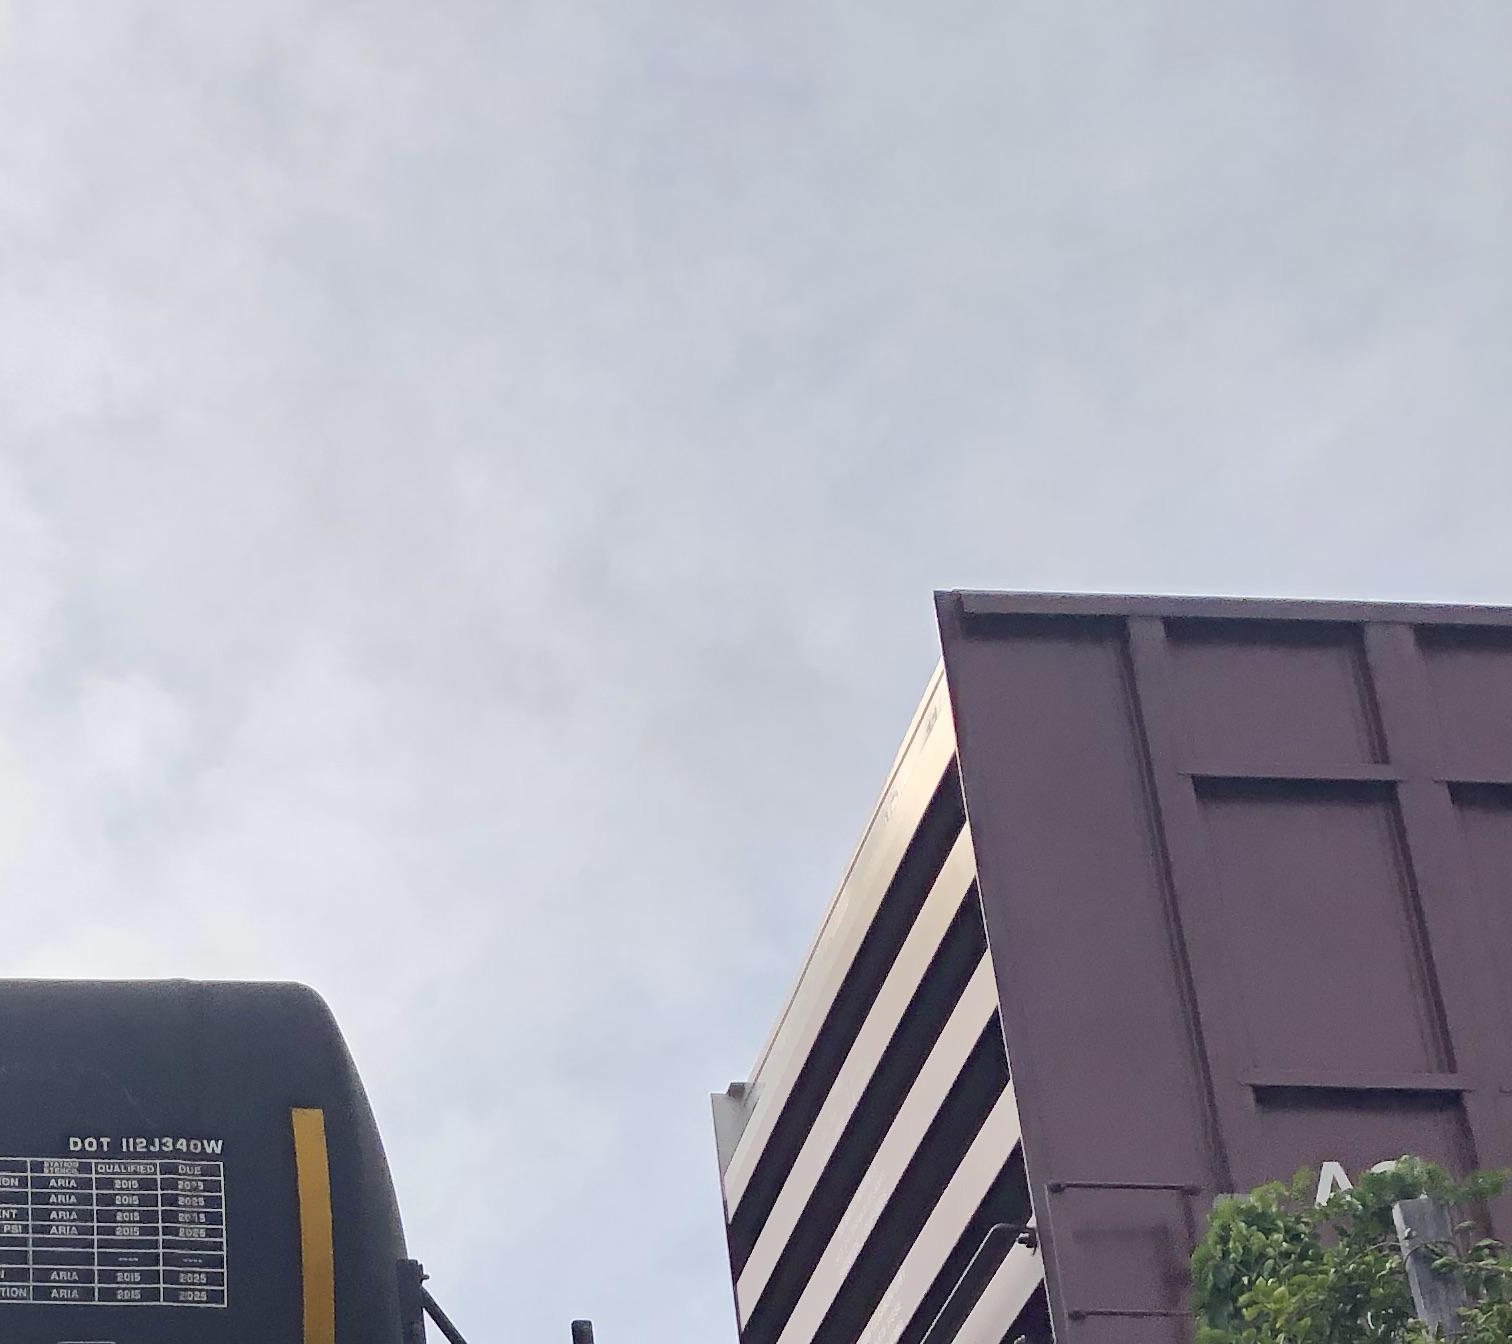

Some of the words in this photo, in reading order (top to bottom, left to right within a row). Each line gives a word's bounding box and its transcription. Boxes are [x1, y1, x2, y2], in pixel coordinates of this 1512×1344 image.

[69, 1138, 111, 1152] DOT
[98, 1164, 155, 1174] QUALIFIED
[178, 1165, 202, 1174] DUE
[48, 1179, 77, 1188] ARIA
[49, 1194, 77, 1203] ARIA
[49, 1211, 77, 1220] ARIA
[3, 1225, 22, 1234] PSI
[50, 1225, 78, 1235] ARIA
[116, 1227, 140, 1236] 2015
[50, 1271, 79, 1281] ARIA
[116, 1273, 141, 1282] 2015
[51, 1289, 79, 1299] ARIA
